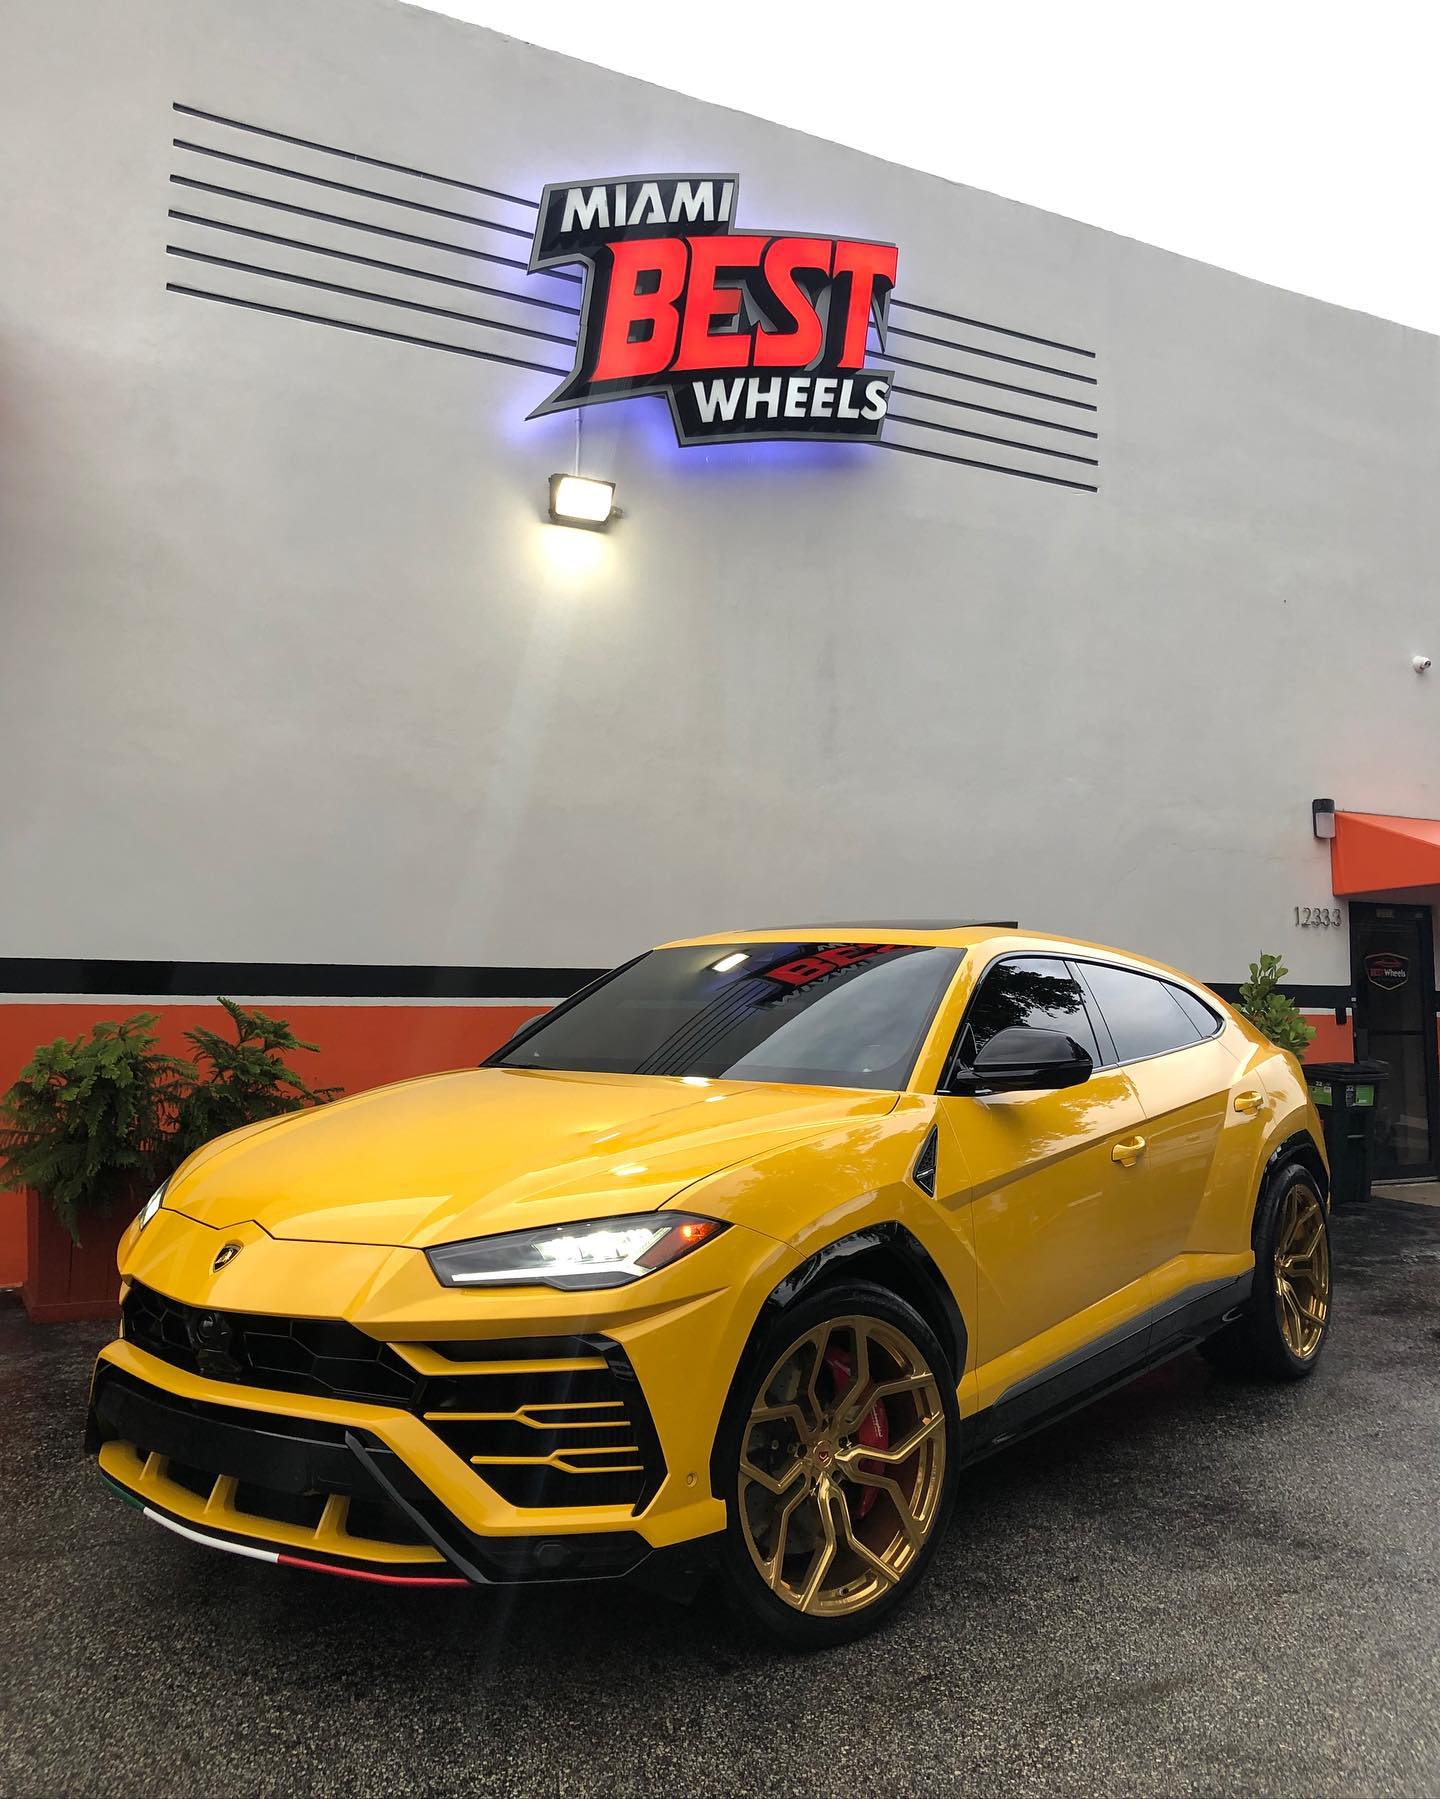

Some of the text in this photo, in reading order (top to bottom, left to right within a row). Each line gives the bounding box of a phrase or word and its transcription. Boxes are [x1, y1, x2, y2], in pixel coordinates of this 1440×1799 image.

[560, 180, 735, 233] MIAMI
[588, 234, 899, 383] BEST
[692, 376, 891, 424] WHEELS
[1294, 906, 1342, 928] 12333
